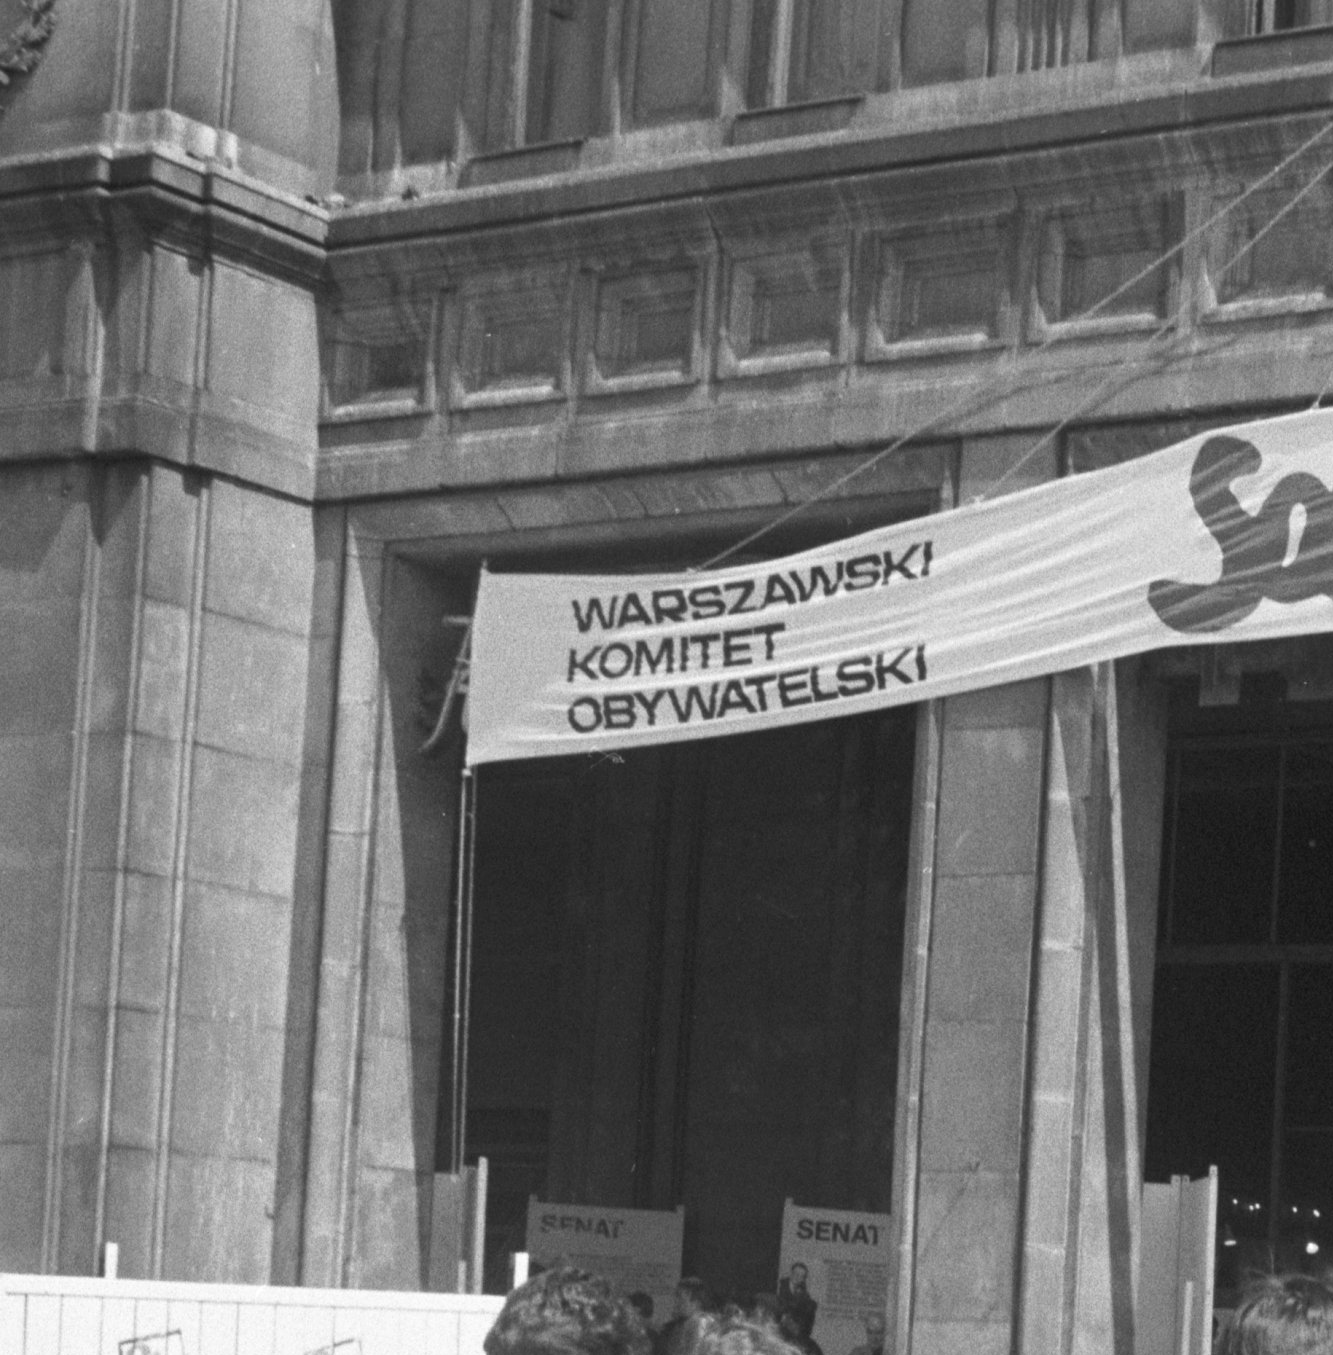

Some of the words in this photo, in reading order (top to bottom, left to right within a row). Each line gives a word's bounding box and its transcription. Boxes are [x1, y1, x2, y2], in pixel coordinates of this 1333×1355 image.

[571, 540, 934, 633] WARSZAWSKI
[567, 622, 786, 683] KOMITET
[567, 643, 927, 734] OBYWATELSKI
[538, 1212, 625, 1239] SENAT
[796, 1218, 879, 1246] SENAT
